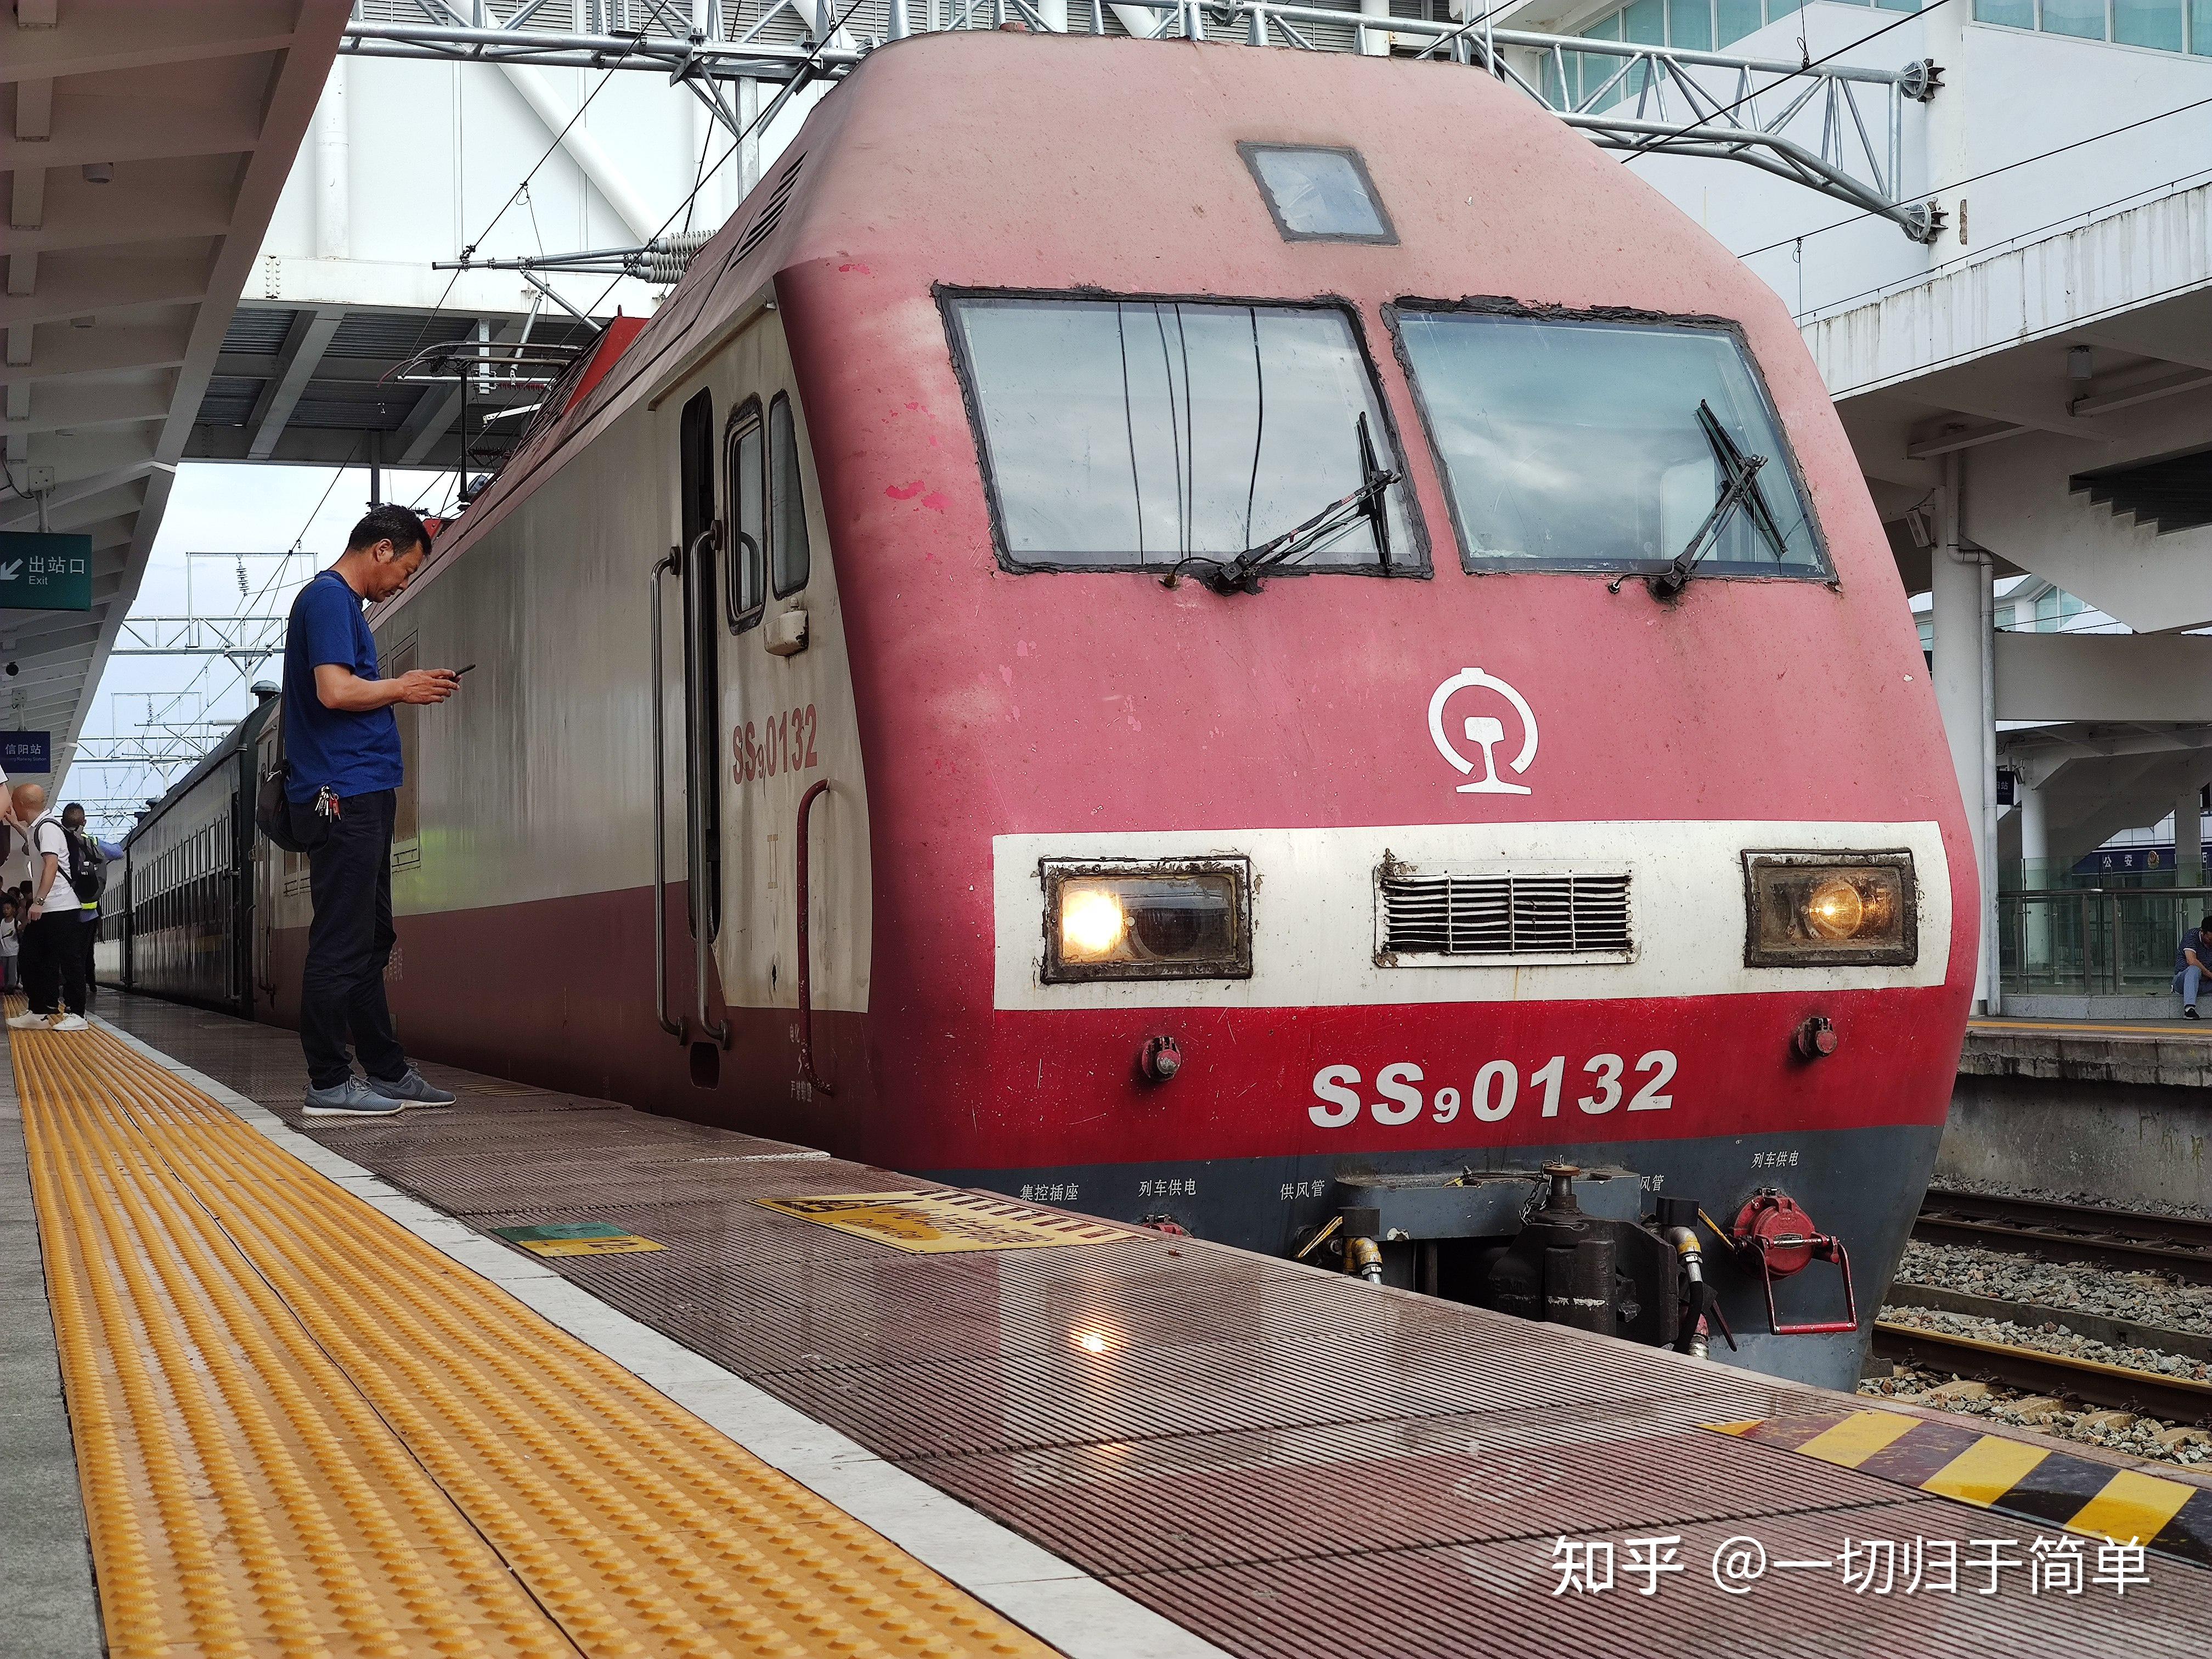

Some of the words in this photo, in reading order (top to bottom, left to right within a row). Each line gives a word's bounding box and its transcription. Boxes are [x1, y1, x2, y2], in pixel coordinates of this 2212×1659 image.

[29, 556, 84, 574] 出站口
[29, 575, 48, 585] Exit
[5, 743, 42, 755] 信阳站
[1307, 1049, 1678, 1128] SS90132
[1751, 1150, 1799, 1169] 列车供电
[1019, 1183, 1079, 1201] 集控插座
[1138, 1178, 1197, 1197] 列车供电
[1280, 1180, 1325, 1200] 供风管
